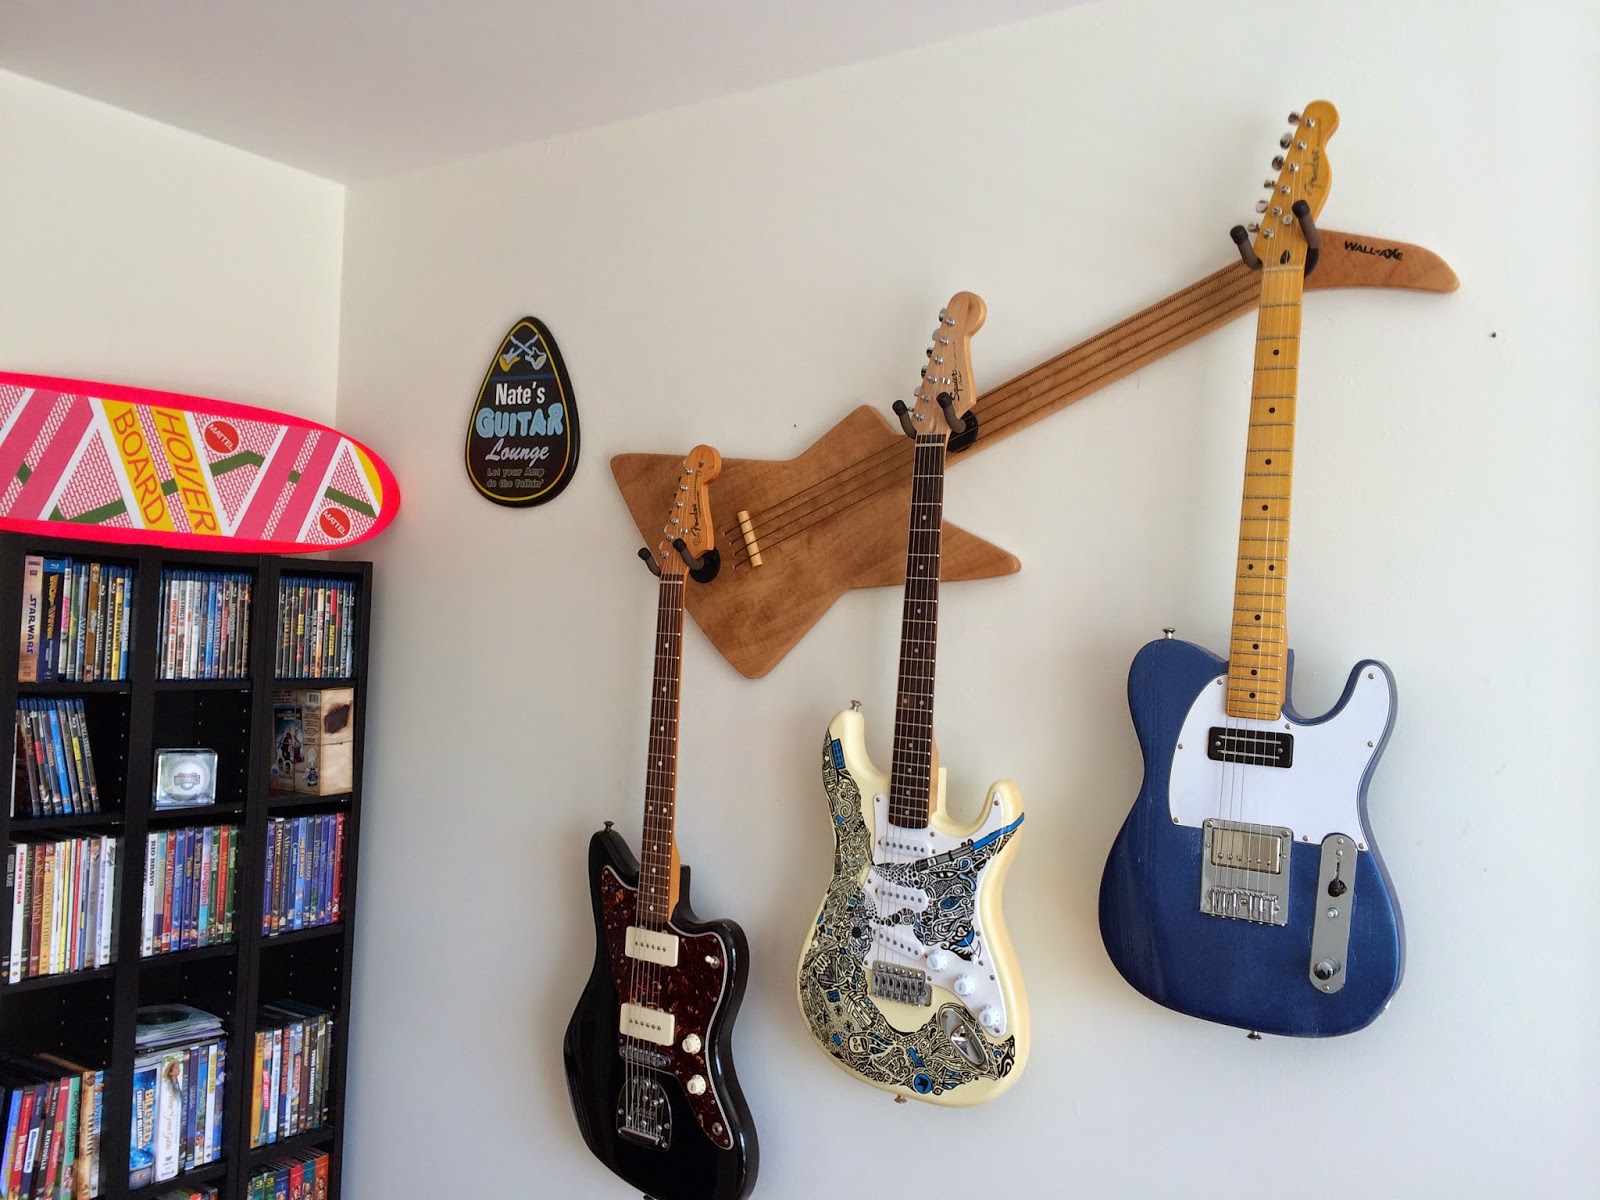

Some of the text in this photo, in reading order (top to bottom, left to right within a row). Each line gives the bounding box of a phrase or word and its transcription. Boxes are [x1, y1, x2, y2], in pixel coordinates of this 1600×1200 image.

[495, 381, 546, 406] Nate's
[475, 402, 564, 439] GUITAR
[207, 421, 237, 452] MATTEL
[112, 407, 166, 525] BOARD
[485, 438, 550, 467] Lounge
[155, 410, 217, 533] HOVER
[487, 467, 545, 478] Let your Amp
[487, 479, 497, 488] do
[499, 479, 513, 488] the
[322, 510, 347, 538] MATTEL
[27, 595, 36, 654] STAR WARS
[35, 851, 44, 880] GONE
[167, 849, 175, 867] Mary
[32, 894, 42, 925] WIND
[71, 1091, 79, 1120] GHOST
